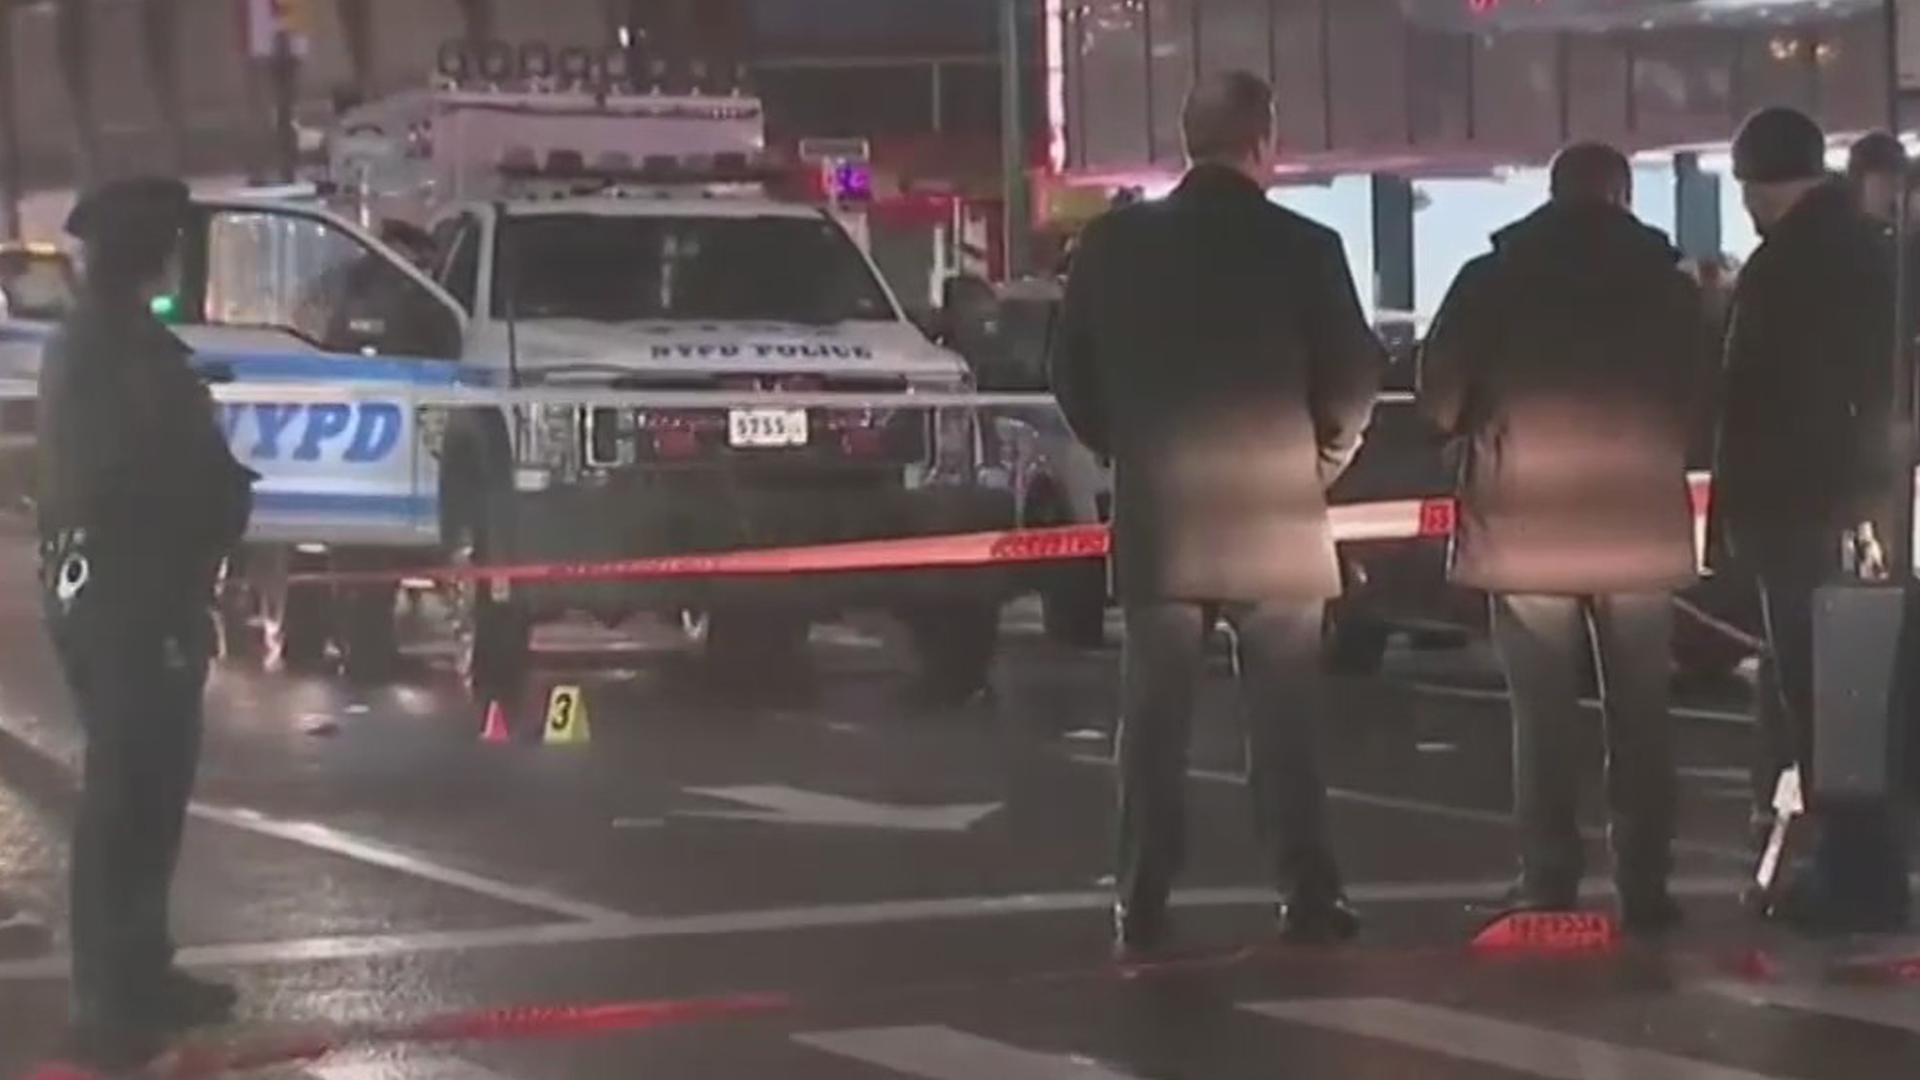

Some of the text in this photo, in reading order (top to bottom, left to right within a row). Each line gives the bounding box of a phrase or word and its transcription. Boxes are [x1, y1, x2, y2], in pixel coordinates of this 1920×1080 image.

[651, 343, 873, 360] NYPD POLICE
[551, 692, 572, 731] 3
